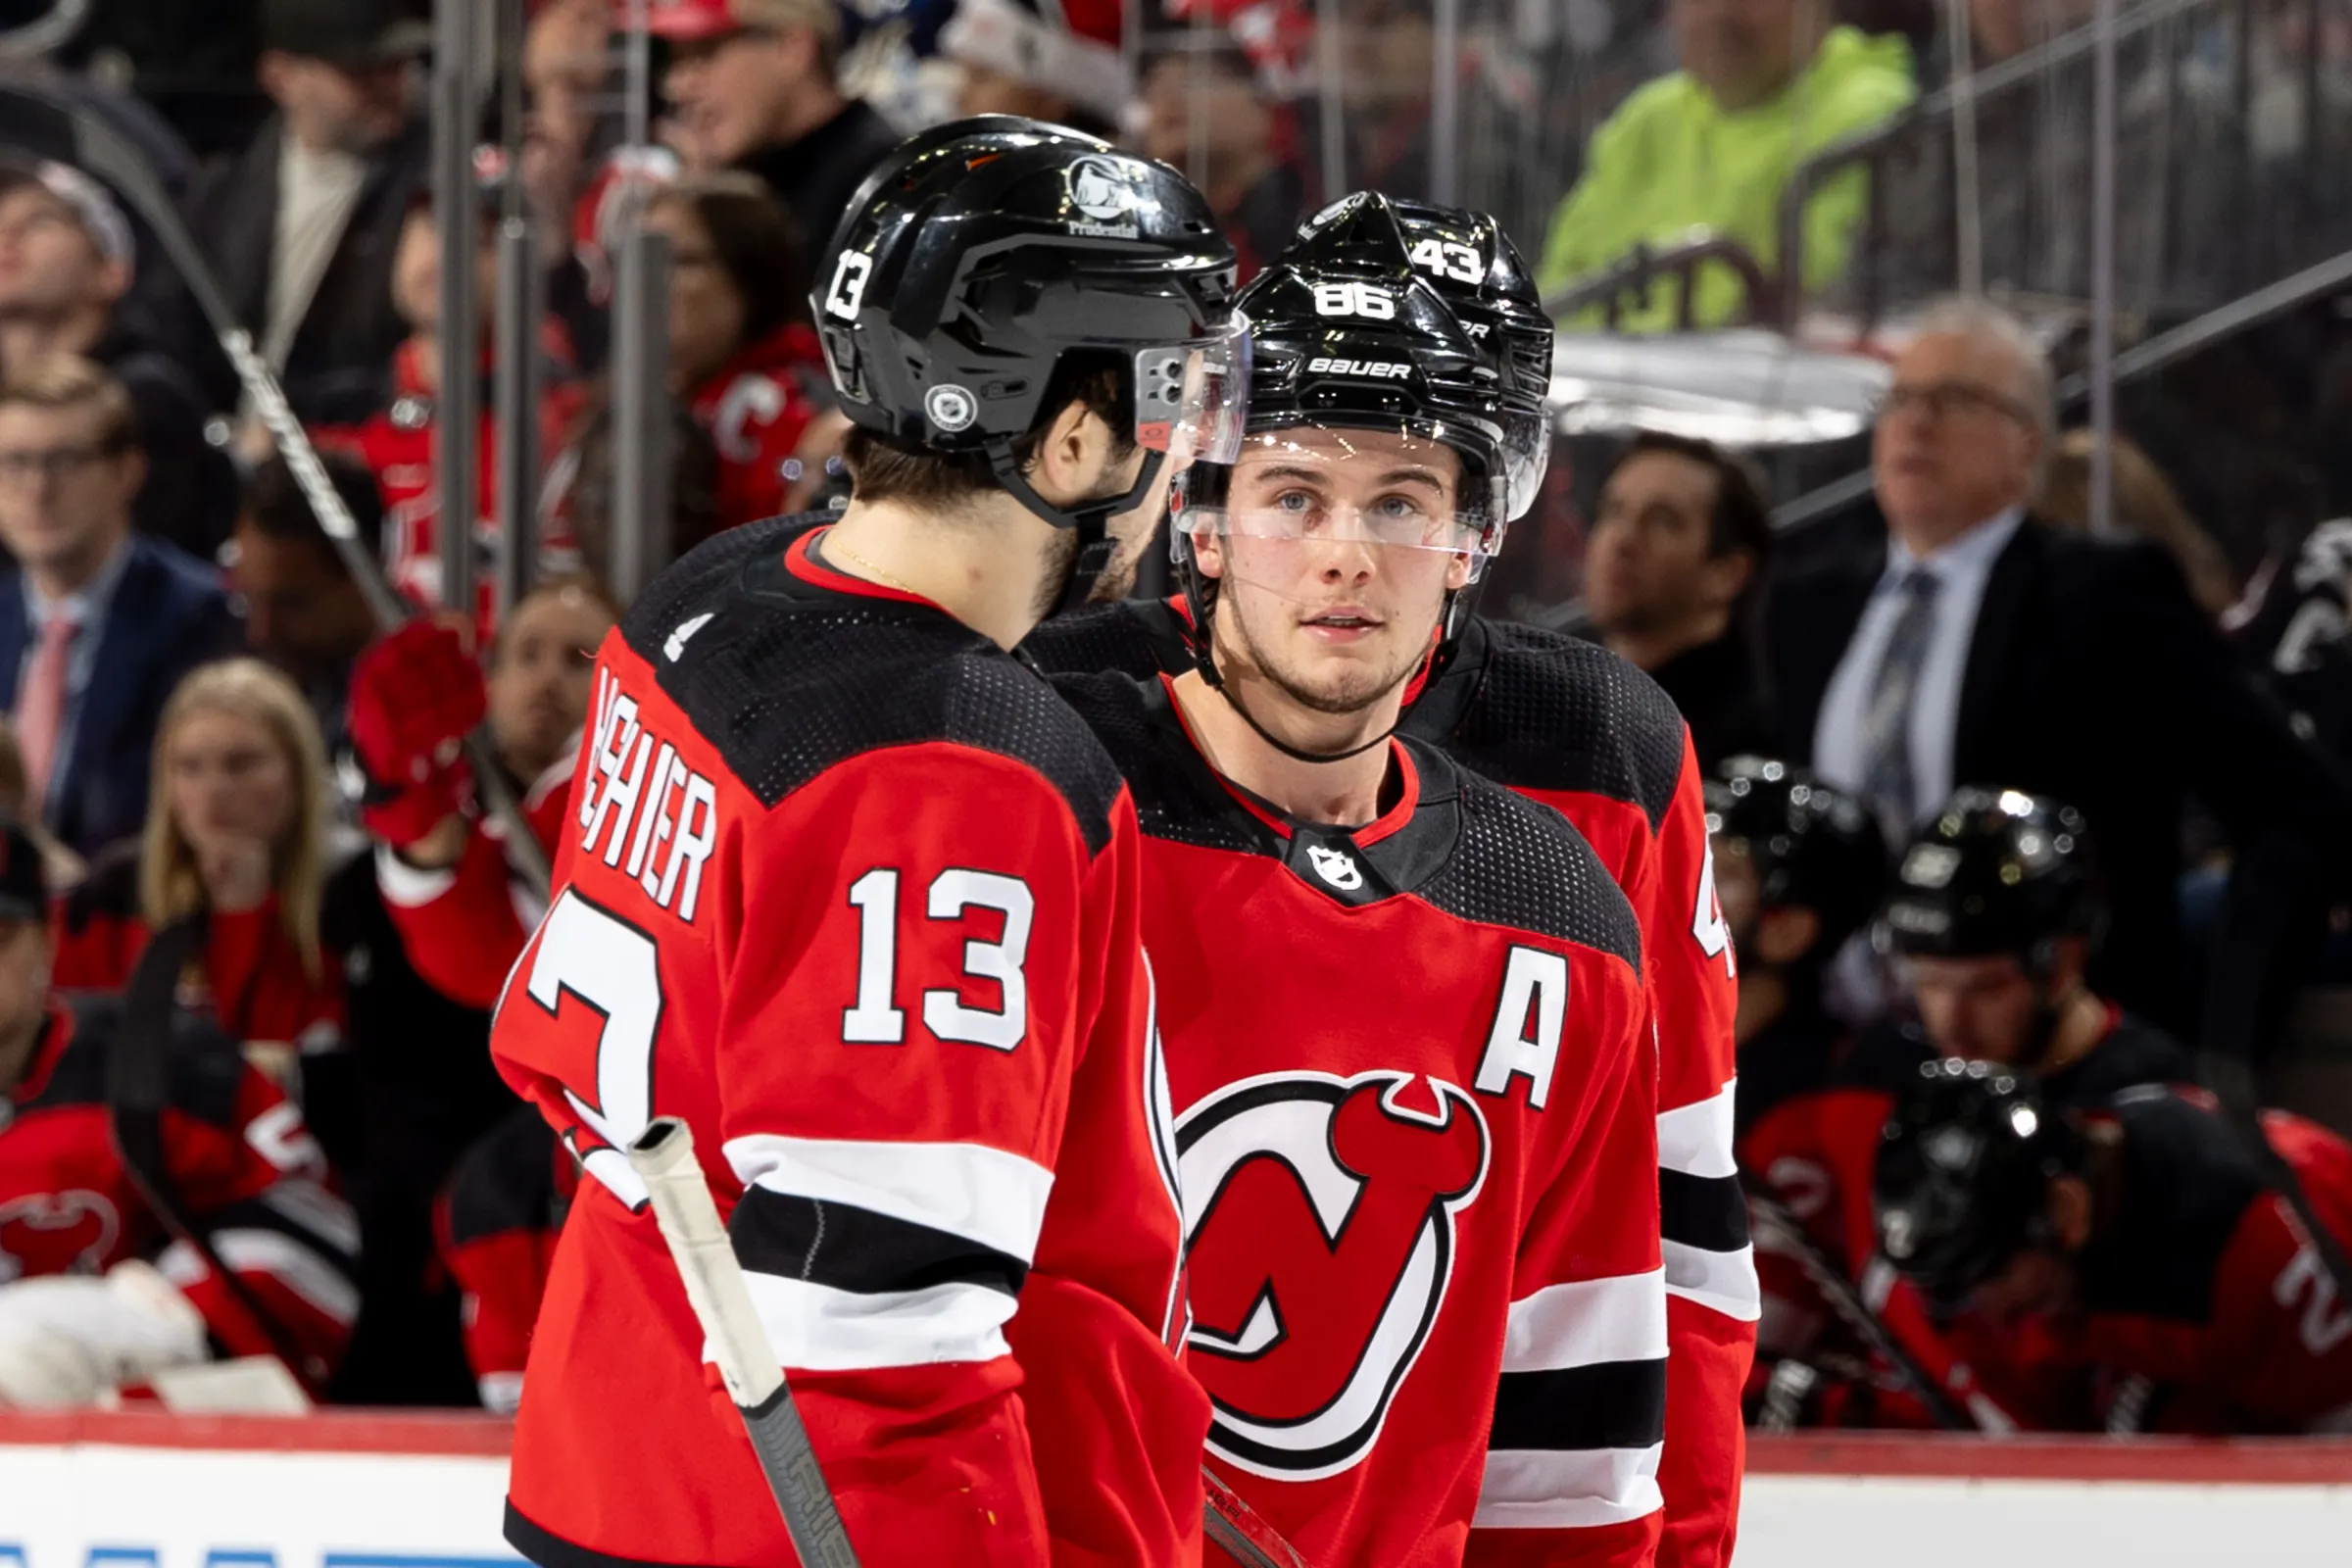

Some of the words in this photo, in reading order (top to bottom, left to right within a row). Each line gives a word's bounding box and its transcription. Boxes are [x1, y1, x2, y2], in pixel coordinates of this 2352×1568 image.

[825, 249, 872, 320] 13
[1410, 238, 1486, 285] 43
[1313, 282, 1395, 320] 86
[1307, 358, 1411, 379] BAUER
[842, 866, 1035, 1053] 13
[1474, 942, 1568, 1113] A
